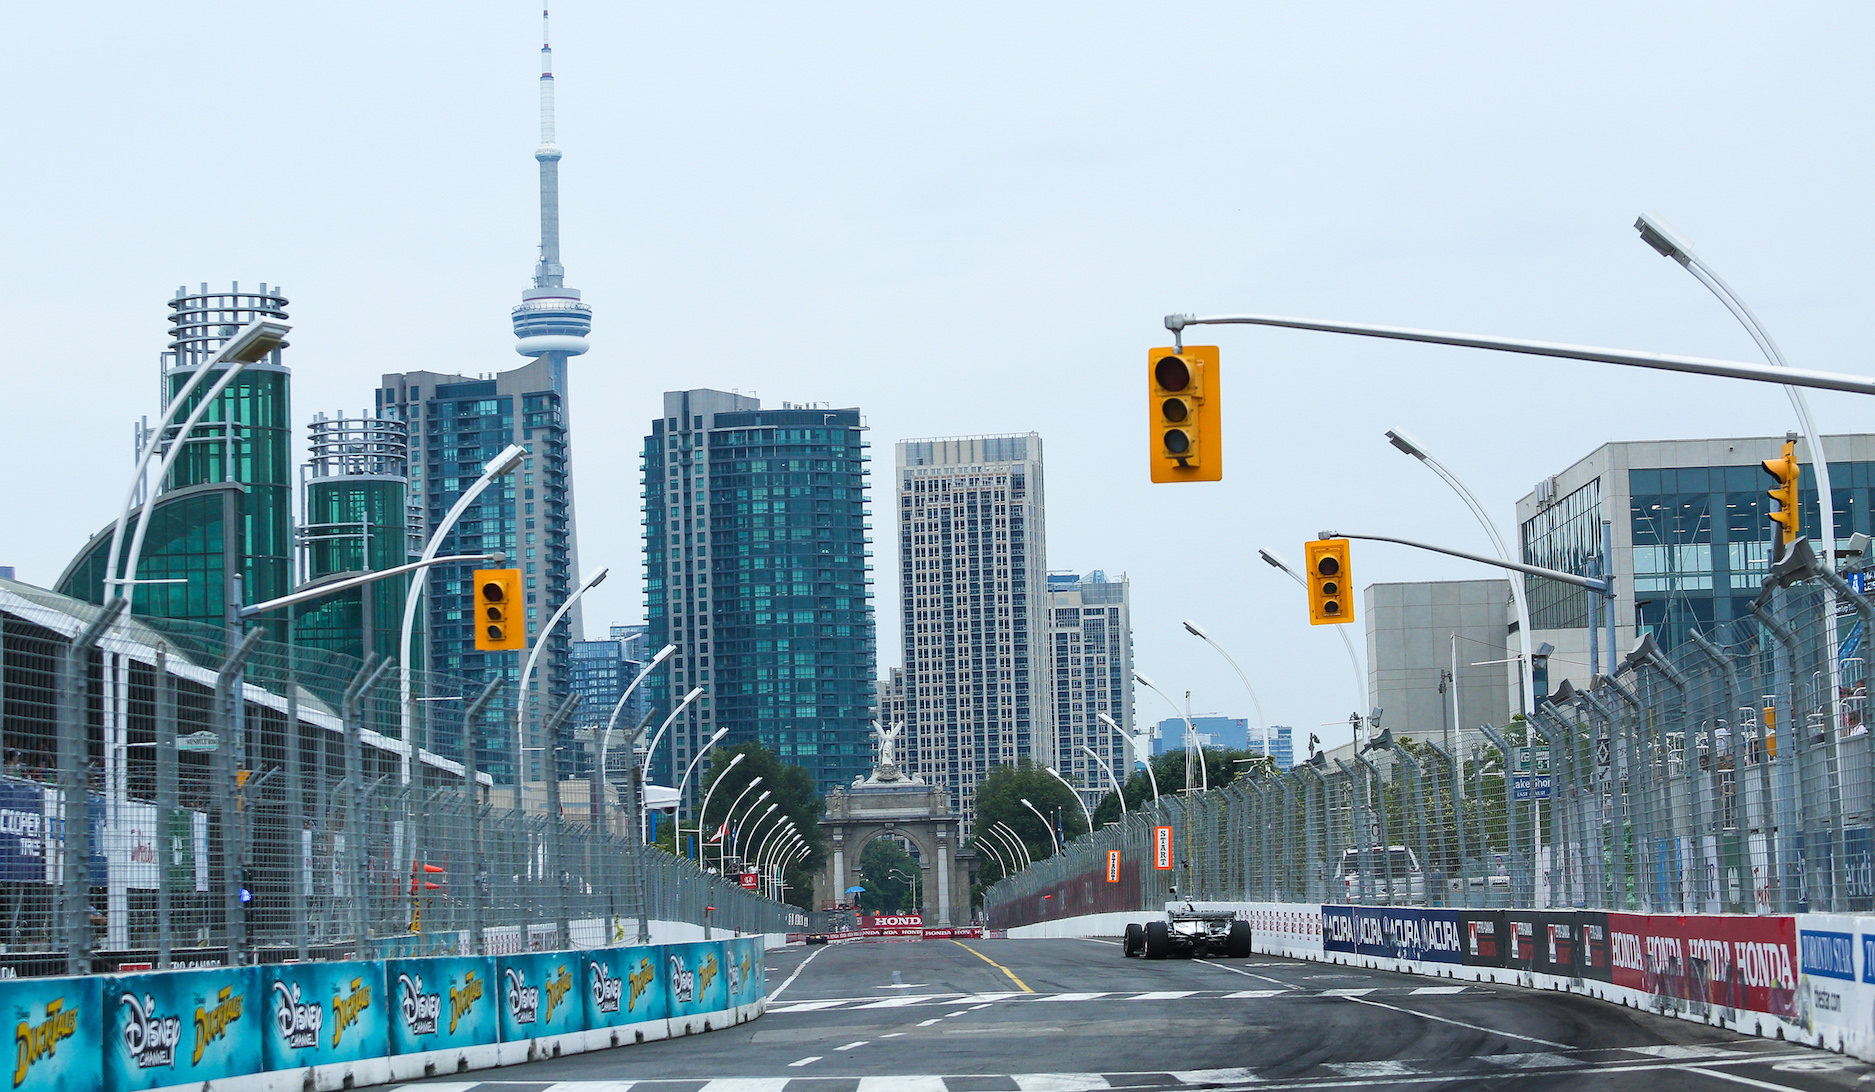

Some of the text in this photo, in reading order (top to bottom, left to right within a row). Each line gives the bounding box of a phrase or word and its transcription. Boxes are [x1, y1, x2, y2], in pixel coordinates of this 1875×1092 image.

[1512, 779, 1530, 789] ake
[874, 917, 922, 926] HOND
[1328, 915, 1354, 943] ACURA
[1360, 917, 1384, 946] ACURA
[1390, 918, 1421, 949] ACURA
[1428, 920, 1462, 952] ACURA
[1610, 931, 1644, 971] HONDA
[1646, 935, 1685, 977] HONDA
[1688, 938, 1731, 982] HONDA
[1735, 941, 1796, 990] HONDA
[1802, 935, 1852, 974] TORONTO STAR
[192, 984, 244, 1067] DUCKTALES
[273, 980, 322, 1051] DISNEY
[398, 972, 441, 1037] DISNEY
[13, 996, 79, 1089] DUCKTALES
[120, 991, 180, 1070] DISNEY
[290, 1033, 317, 1047] CHANNEL
[139, 1050, 171, 1067] CHANNEL
